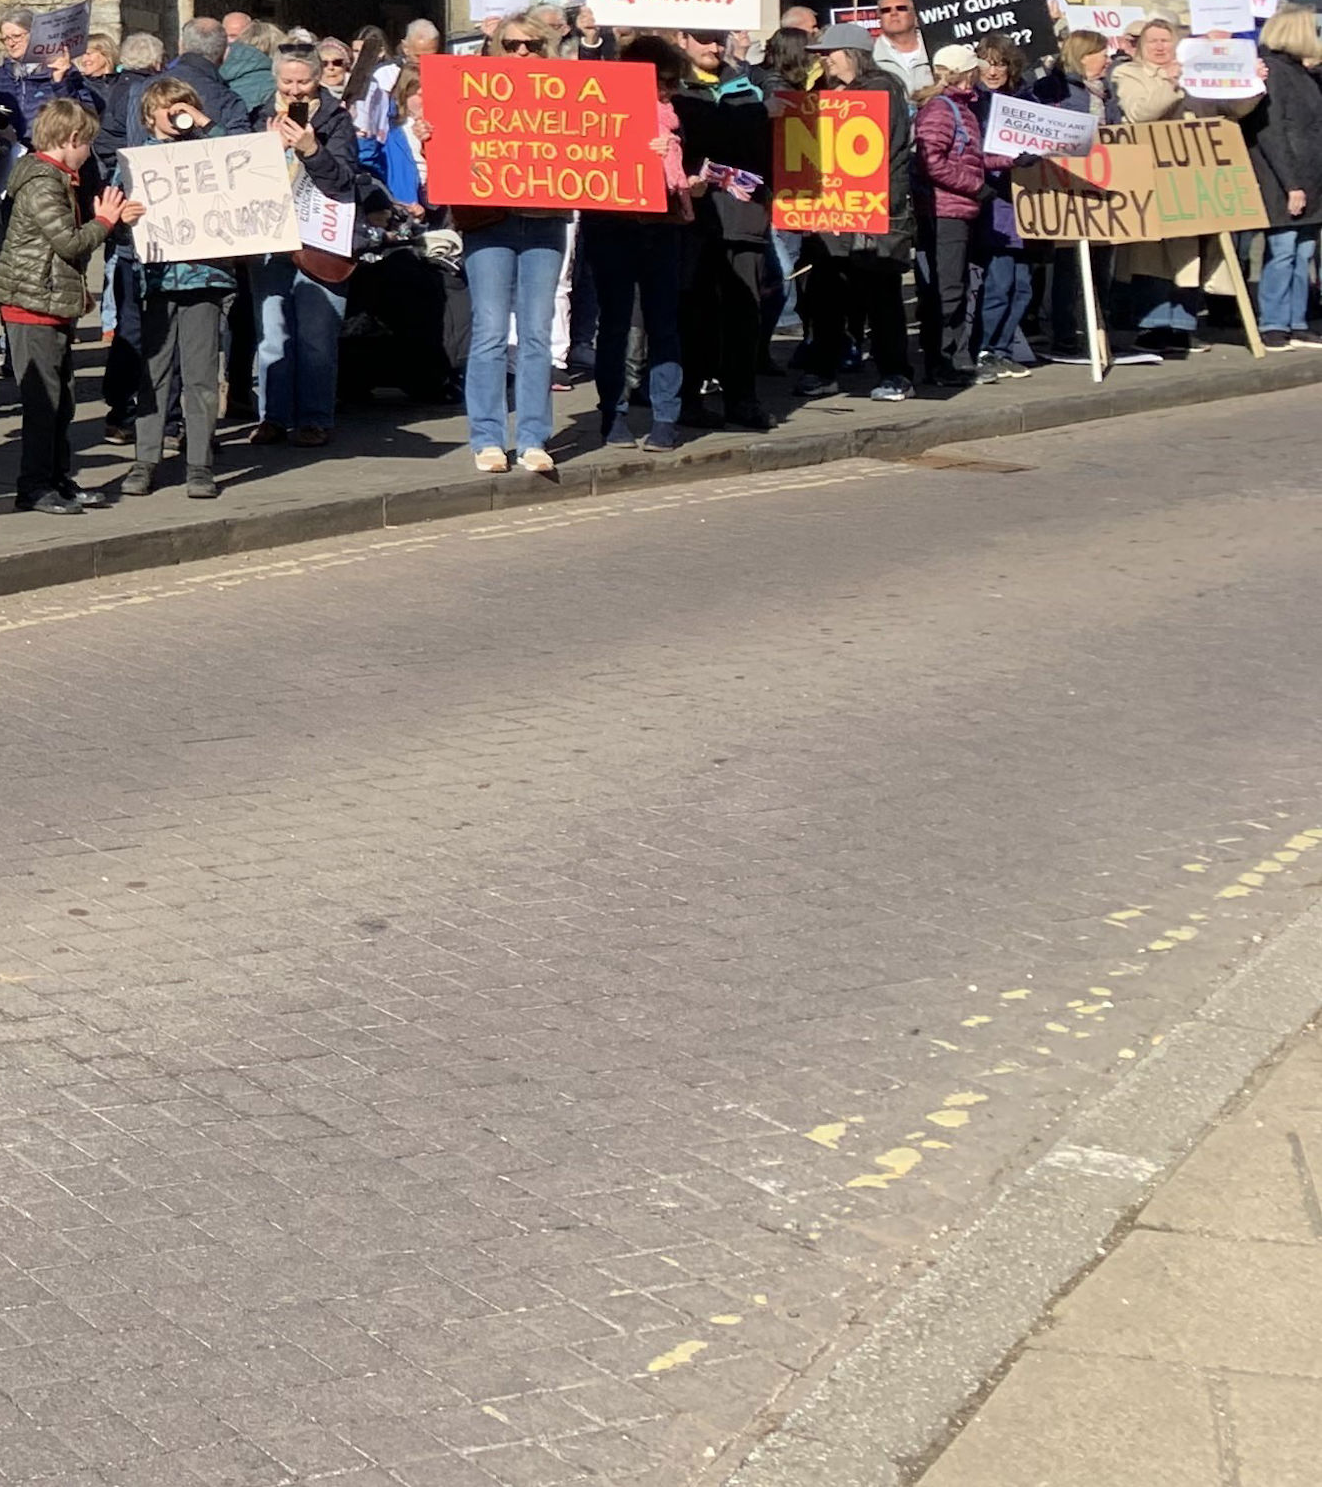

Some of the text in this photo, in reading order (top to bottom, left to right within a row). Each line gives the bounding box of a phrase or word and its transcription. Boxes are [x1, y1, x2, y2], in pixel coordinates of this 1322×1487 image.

[919, 1, 961, 25] WHY
[954, 11, 1017, 39] IN OUR
[1092, 11, 1120, 29] NO
[462, 71, 607, 103] NO TO A
[802, 93, 867, 119] Say
[1002, 106, 1036, 120] BEEP
[999, 129, 1081, 152] QUARRY
[1005, 117, 1061, 138] AGAINST
[470, 140, 617, 162] NEXT TO OUR
[784, 115, 886, 178] NO
[141, 148, 252, 206] BEEP
[470, 161, 648, 206] SCHOOL!
[818, 174, 843, 188] to
[776, 189, 889, 215] CEMEX
[1155, 167, 1258, 222] LLAGE
[146, 193, 293, 246] NO QUARRY
[321, 202, 339, 242] QUA
[783, 212, 872, 229] QUARRY
[1015, 189, 1155, 237] QUARRY
